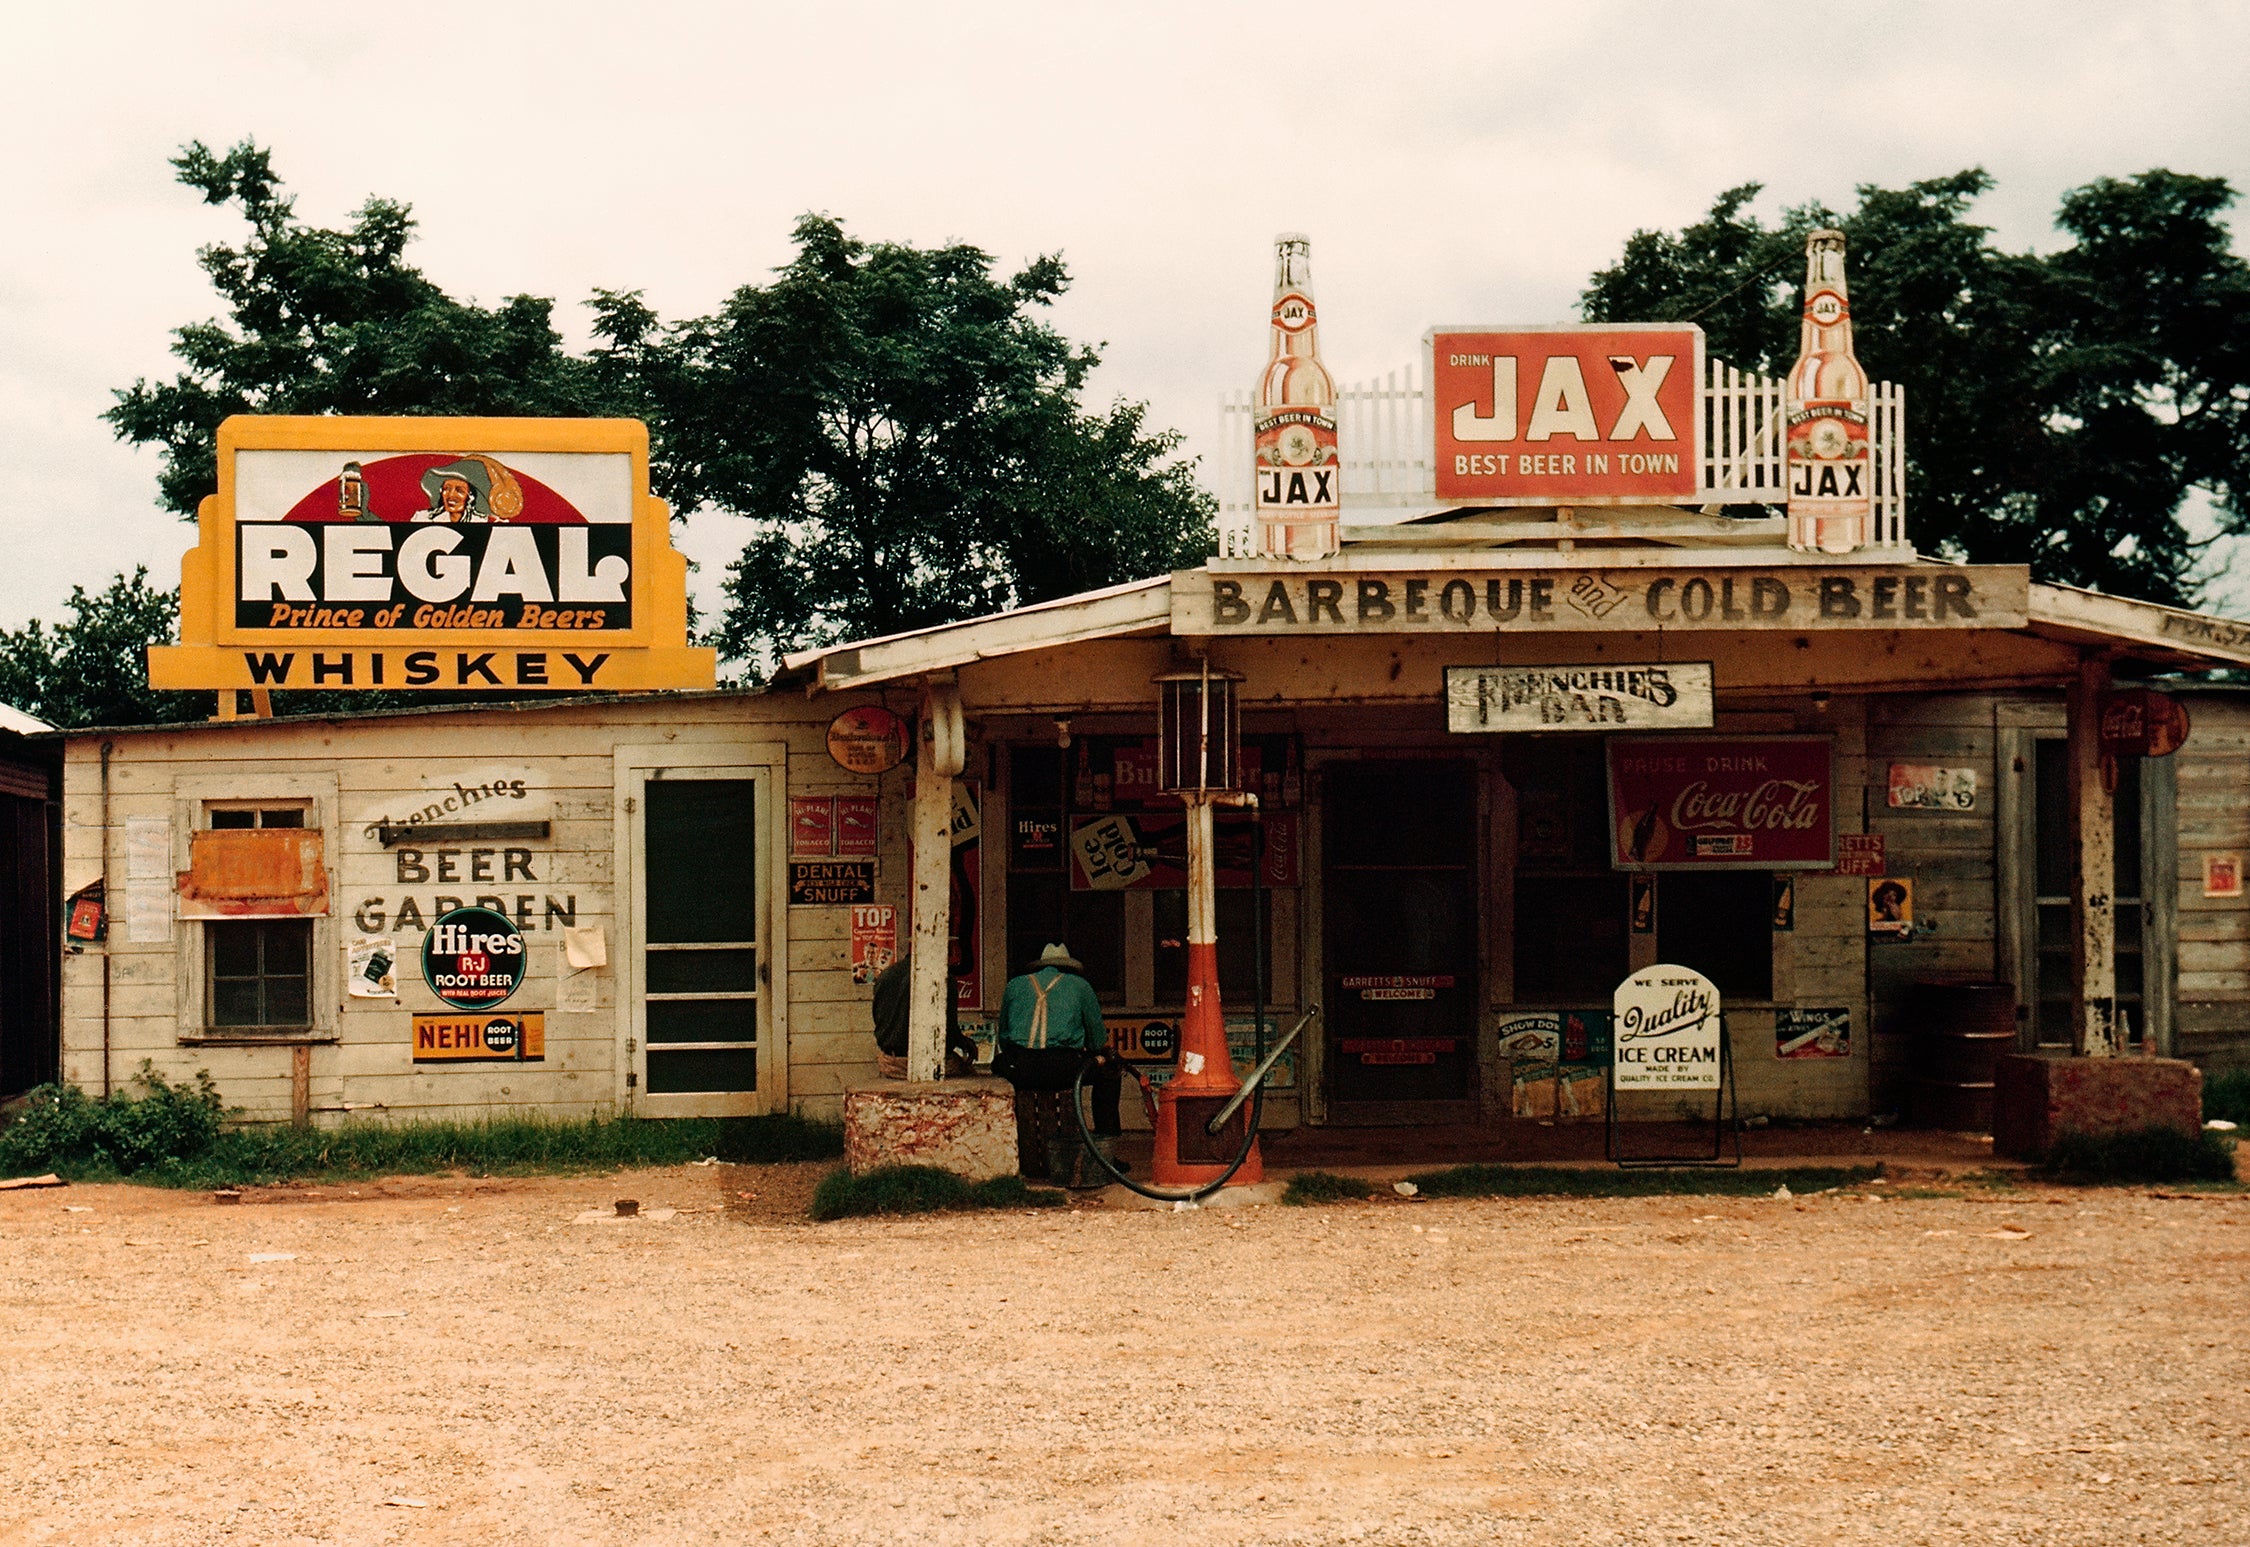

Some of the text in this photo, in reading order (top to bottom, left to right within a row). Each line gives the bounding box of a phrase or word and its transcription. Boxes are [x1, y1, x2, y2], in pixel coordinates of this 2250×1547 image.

[1284, 307, 1304, 319] JAX
[1816, 303, 1836, 314] JAX
[1450, 355, 1490, 367] DRINK
[1452, 355, 1678, 442] JAX
[1260, 414, 1333, 431] BEST BEER IN TOWN
[1455, 454, 1679, 476] BEST BEER IN TOWN
[1263, 471, 1332, 504] JAX
[1794, 465, 1862, 497] JAX
[241, 524, 629, 603] REGAL
[1212, 574, 1979, 627] BARBEQUE and COLD BEER
[270, 603, 606, 629] Prince of Golden Beers
[244, 651, 611, 687] WHISKEY
[1623, 756, 1769, 773] PAUSE DRINK
[1671, 779, 1822, 831] Coca-Cola
[1018, 820, 1058, 834] Hires
[397, 848, 538, 883] BEER
[797, 865, 867, 879] DENTAL
[804, 888, 859, 902] SNUFF
[854, 908, 892, 927] TOP
[432, 924, 522, 955] Hires
[462, 957, 486, 971] R-J
[435, 974, 512, 987] ROOT BEER
[1661, 978, 1699, 986] SERVE
[1375, 990, 1421, 998] WELCOME
[1620, 989, 1714, 1042] Quality
[487, 1026, 512, 1034] ROOT
[1144, 1029, 1168, 1038] ROOT
[1501, 1020, 1536, 1036] SHOW
[418, 1024, 479, 1049] NEHI
[487, 1037, 512, 1045] BEER
[1144, 1039, 1169, 1048] BEER
[1618, 1047, 1715, 1063] ICE CREAM
[1620, 1074, 1651, 1082] QUALITY
[1656, 1074, 1668, 1082] ICE
[1671, 1074, 1699, 1082] CREAM
